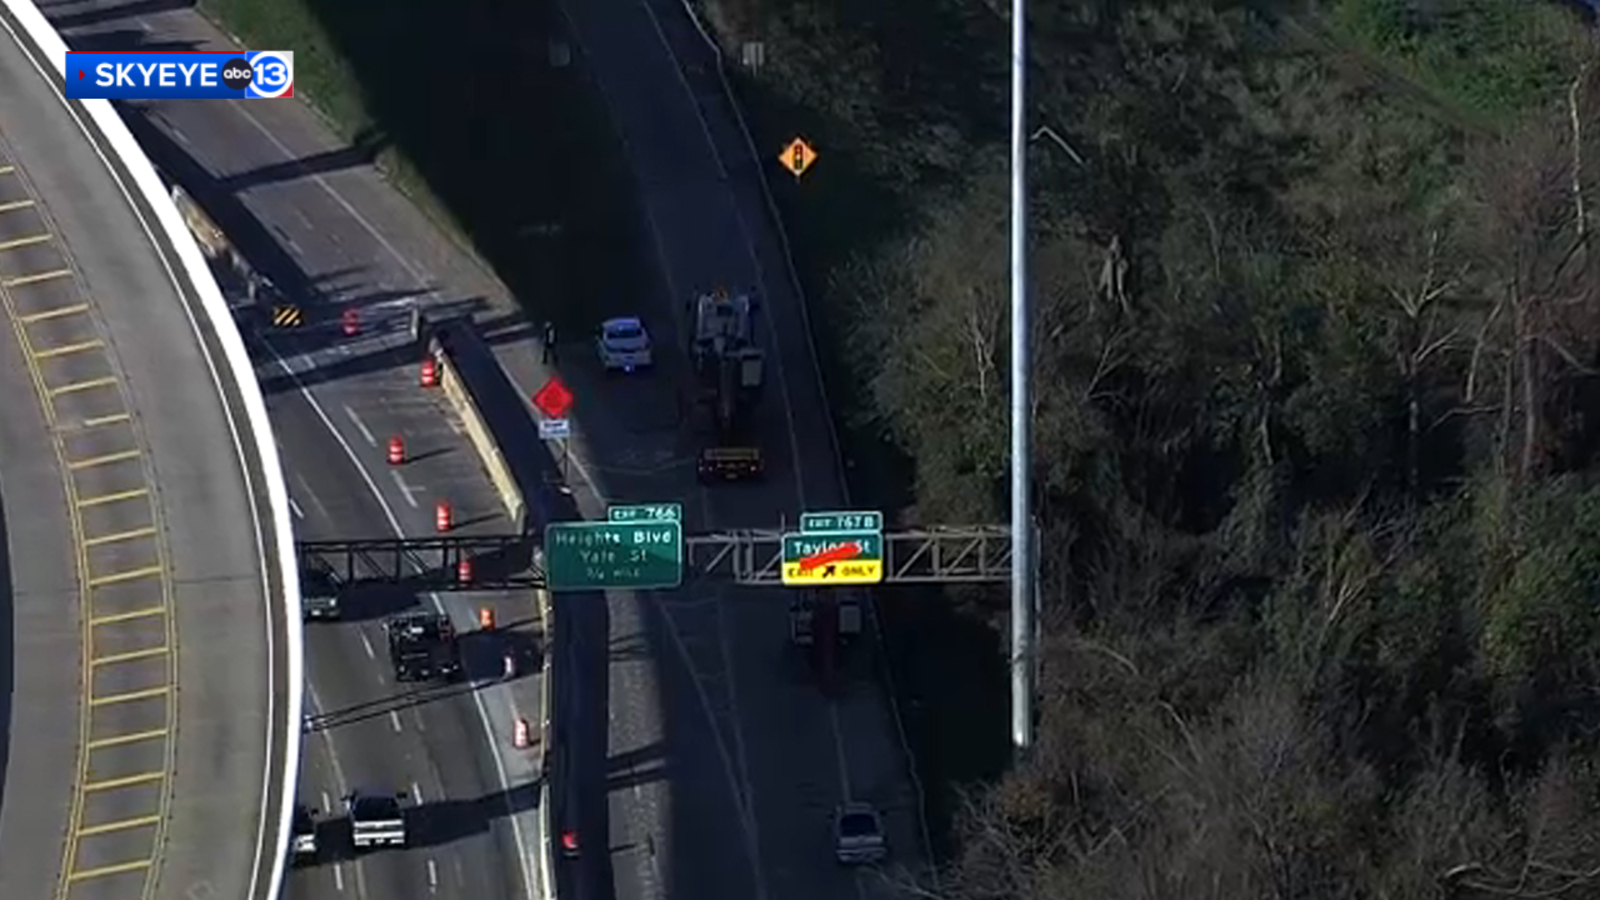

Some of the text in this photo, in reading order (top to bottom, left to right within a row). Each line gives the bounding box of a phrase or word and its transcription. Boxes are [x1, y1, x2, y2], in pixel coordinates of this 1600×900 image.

[645, 507, 676, 521] 766
[555, 530, 672, 547] Heights Blvd
[580, 548, 646, 564] Yale St
[841, 566, 875, 577] ONLY
